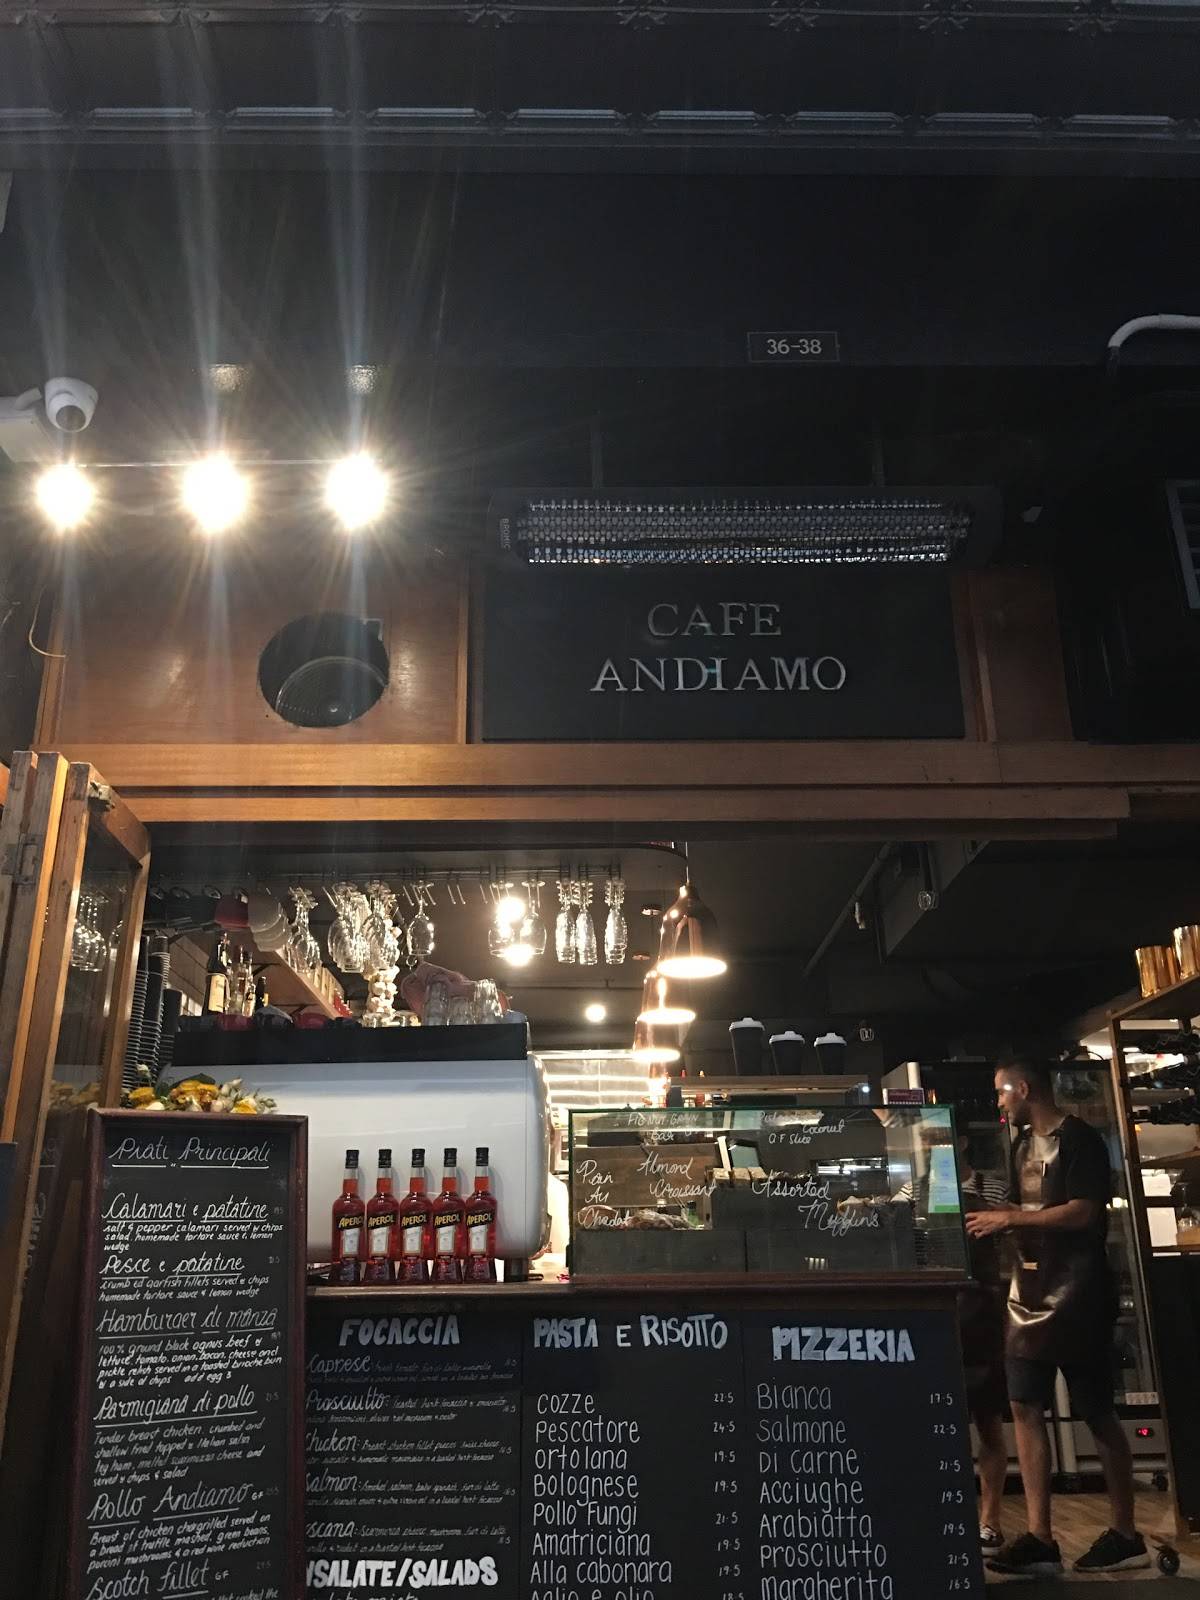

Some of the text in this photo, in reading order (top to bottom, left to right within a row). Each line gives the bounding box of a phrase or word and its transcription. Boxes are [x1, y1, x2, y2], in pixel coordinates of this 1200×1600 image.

[767, 339, 821, 354] 36-38
[647, 602, 782, 638] CAFE
[590, 655, 846, 692] ANDIAMO
[576, 1160, 613, 1185] Pain
[637, 1151, 693, 1180] Almond
[649, 1179, 717, 1199] Croissant
[752, 1167, 831, 1200] Assorted
[102, 1193, 268, 1222] Calamari e patatine
[368, 1215, 394, 1227] APEROL
[401, 1214, 427, 1226] APEROL
[434, 1213, 460, 1226] APEROL
[466, 1213, 493, 1225] APEROL
[799, 1200, 880, 1237] Muffins
[104, 1222, 124, 1232] salt
[136, 1223, 173, 1236] pepper
[177, 1222, 219, 1232] calamari
[223, 1222, 251, 1232] served
[261, 1222, 283, 1231] chips
[104, 1243, 129, 1253] wedge
[99, 1255, 151, 1274] Pesce
[159, 1260, 165, 1272] e
[173, 1251, 245, 1276] patatine
[212, 1275, 238, 1285] served
[248, 1275, 269, 1288] chips
[99, 1291, 141, 1304] homemade
[177, 1290, 198, 1298] sauce
[209, 1287, 232, 1297] lemon
[236, 1287, 260, 1298] wedge
[96, 1307, 197, 1333] Hamburger
[201, 1304, 221, 1328] di
[339, 1315, 460, 1346] FOCACCIA
[533, 1314, 728, 1349] PASTA E RISOTTO
[128, 1340, 163, 1357] ground
[165, 1337, 190, 1352] black
[225, 1334, 252, 1348] beef
[228, 1346, 278, 1359] cheese and
[772, 1325, 916, 1362] PIZZERIA
[97, 1366, 125, 1382] pickle
[128, 1363, 151, 1376] relish
[154, 1362, 181, 1374] served
[200, 1358, 229, 1371] toasted
[263, 1356, 282, 1365] bun
[109, 1380, 116, 1388] a
[118, 1375, 135, 1387] side
[149, 1375, 172, 1387] chips
[207, 1372, 223, 1383] egg
[93, 1384, 255, 1424] Parmigiana di pollo
[757, 1376, 832, 1410] Bianca
[94, 1417, 266, 1444] Tender breast crumbed and
[156, 1439, 187, 1457] topped
[216, 1451, 242, 1460] cheese
[246, 1445, 265, 1458] and
[535, 1445, 627, 1470] ortolana
[759, 1446, 778, 1473] Di
[93, 1476, 118, 1487] served
[162, 1466, 189, 1480] salad
[534, 1472, 639, 1506] Bolognese
[86, 1488, 146, 1521] Pollo
[153, 1481, 254, 1512] Andiamo
[759, 1477, 864, 1514] Acciughe
[89, 1530, 120, 1546] Breast
[122, 1528, 136, 1541] of
[138, 1523, 174, 1539] chicken
[231, 1510, 258, 1527] served
[259, 1513, 271, 1523] on
[533, 1500, 638, 1534] Pollo Fungi
[759, 1507, 873, 1538] Arabiatta
[89, 1549, 96, 1557] a
[217, 1529, 240, 1544] green
[533, 1528, 650, 1556] Amatriciana
[85, 1569, 149, 1600] Scotch
[156, 1558, 209, 1592] fillet
[530, 1559, 567, 1584] Alla
